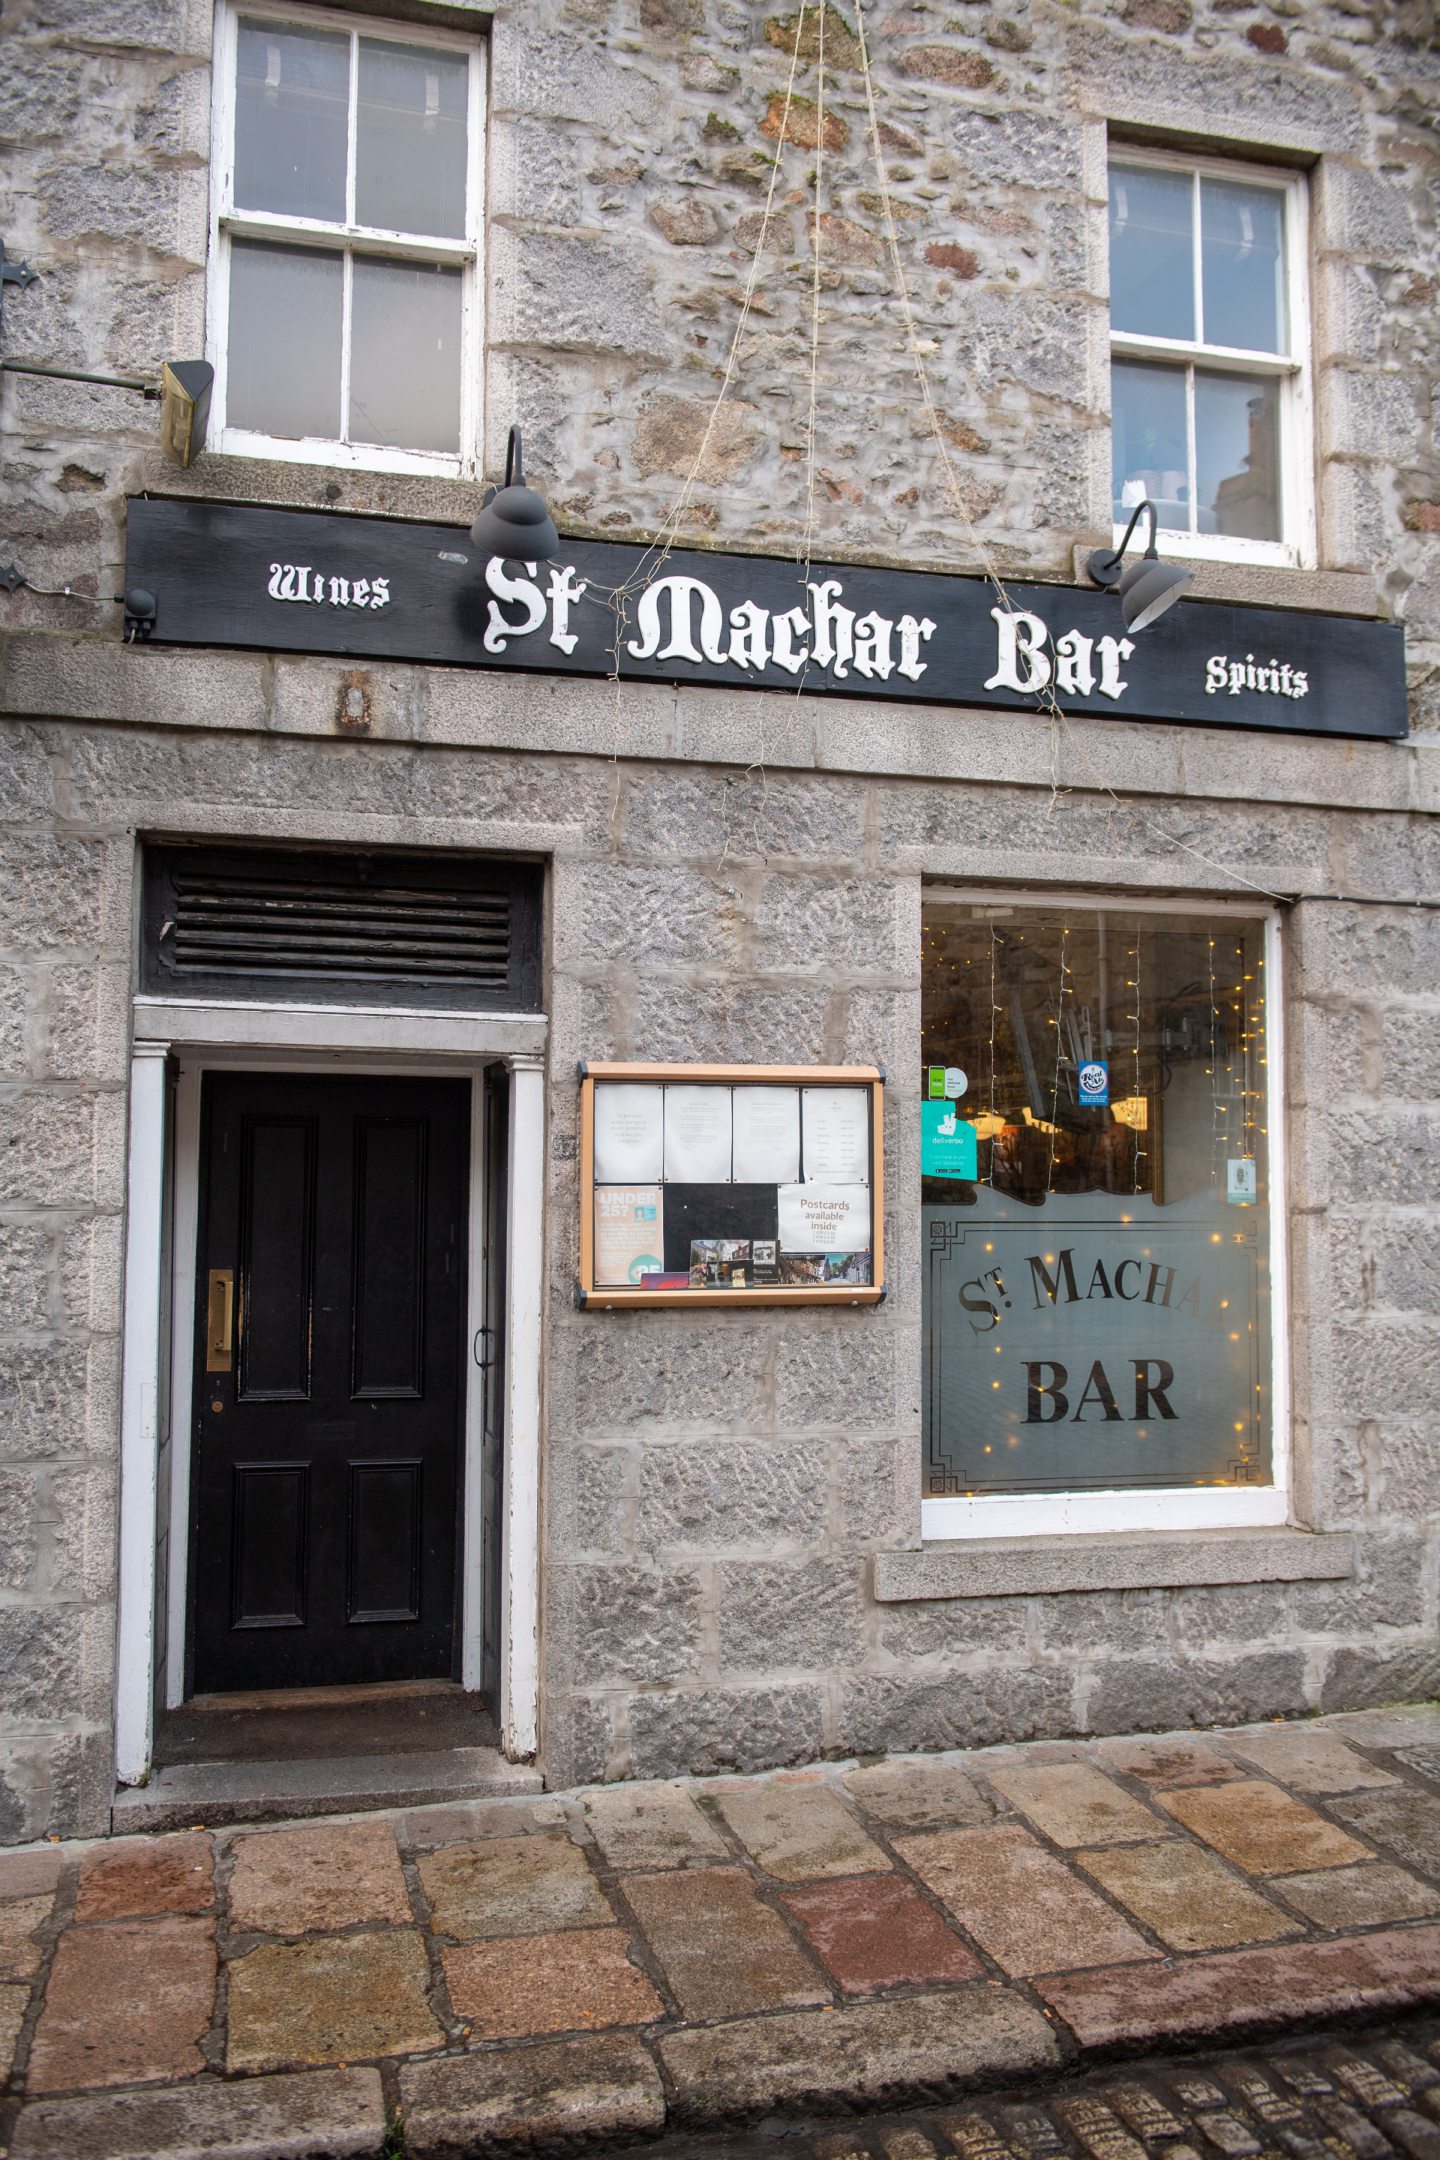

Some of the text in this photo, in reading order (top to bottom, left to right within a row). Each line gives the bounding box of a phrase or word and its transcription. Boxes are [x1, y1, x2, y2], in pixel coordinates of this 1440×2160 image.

[268, 562, 391, 610] Wines
[483, 556, 1138, 700] St Machar Bar
[1204, 654, 1310, 699] Spirits
[600, 1192, 657, 1205] UNDER
[800, 1199, 850, 1211] Postcards
[601, 1205, 629, 1217] 25?
[805, 1211, 844, 1221] available
[811, 1221, 837, 1231] inside
[1020, 1358, 1180, 1425] BAR
